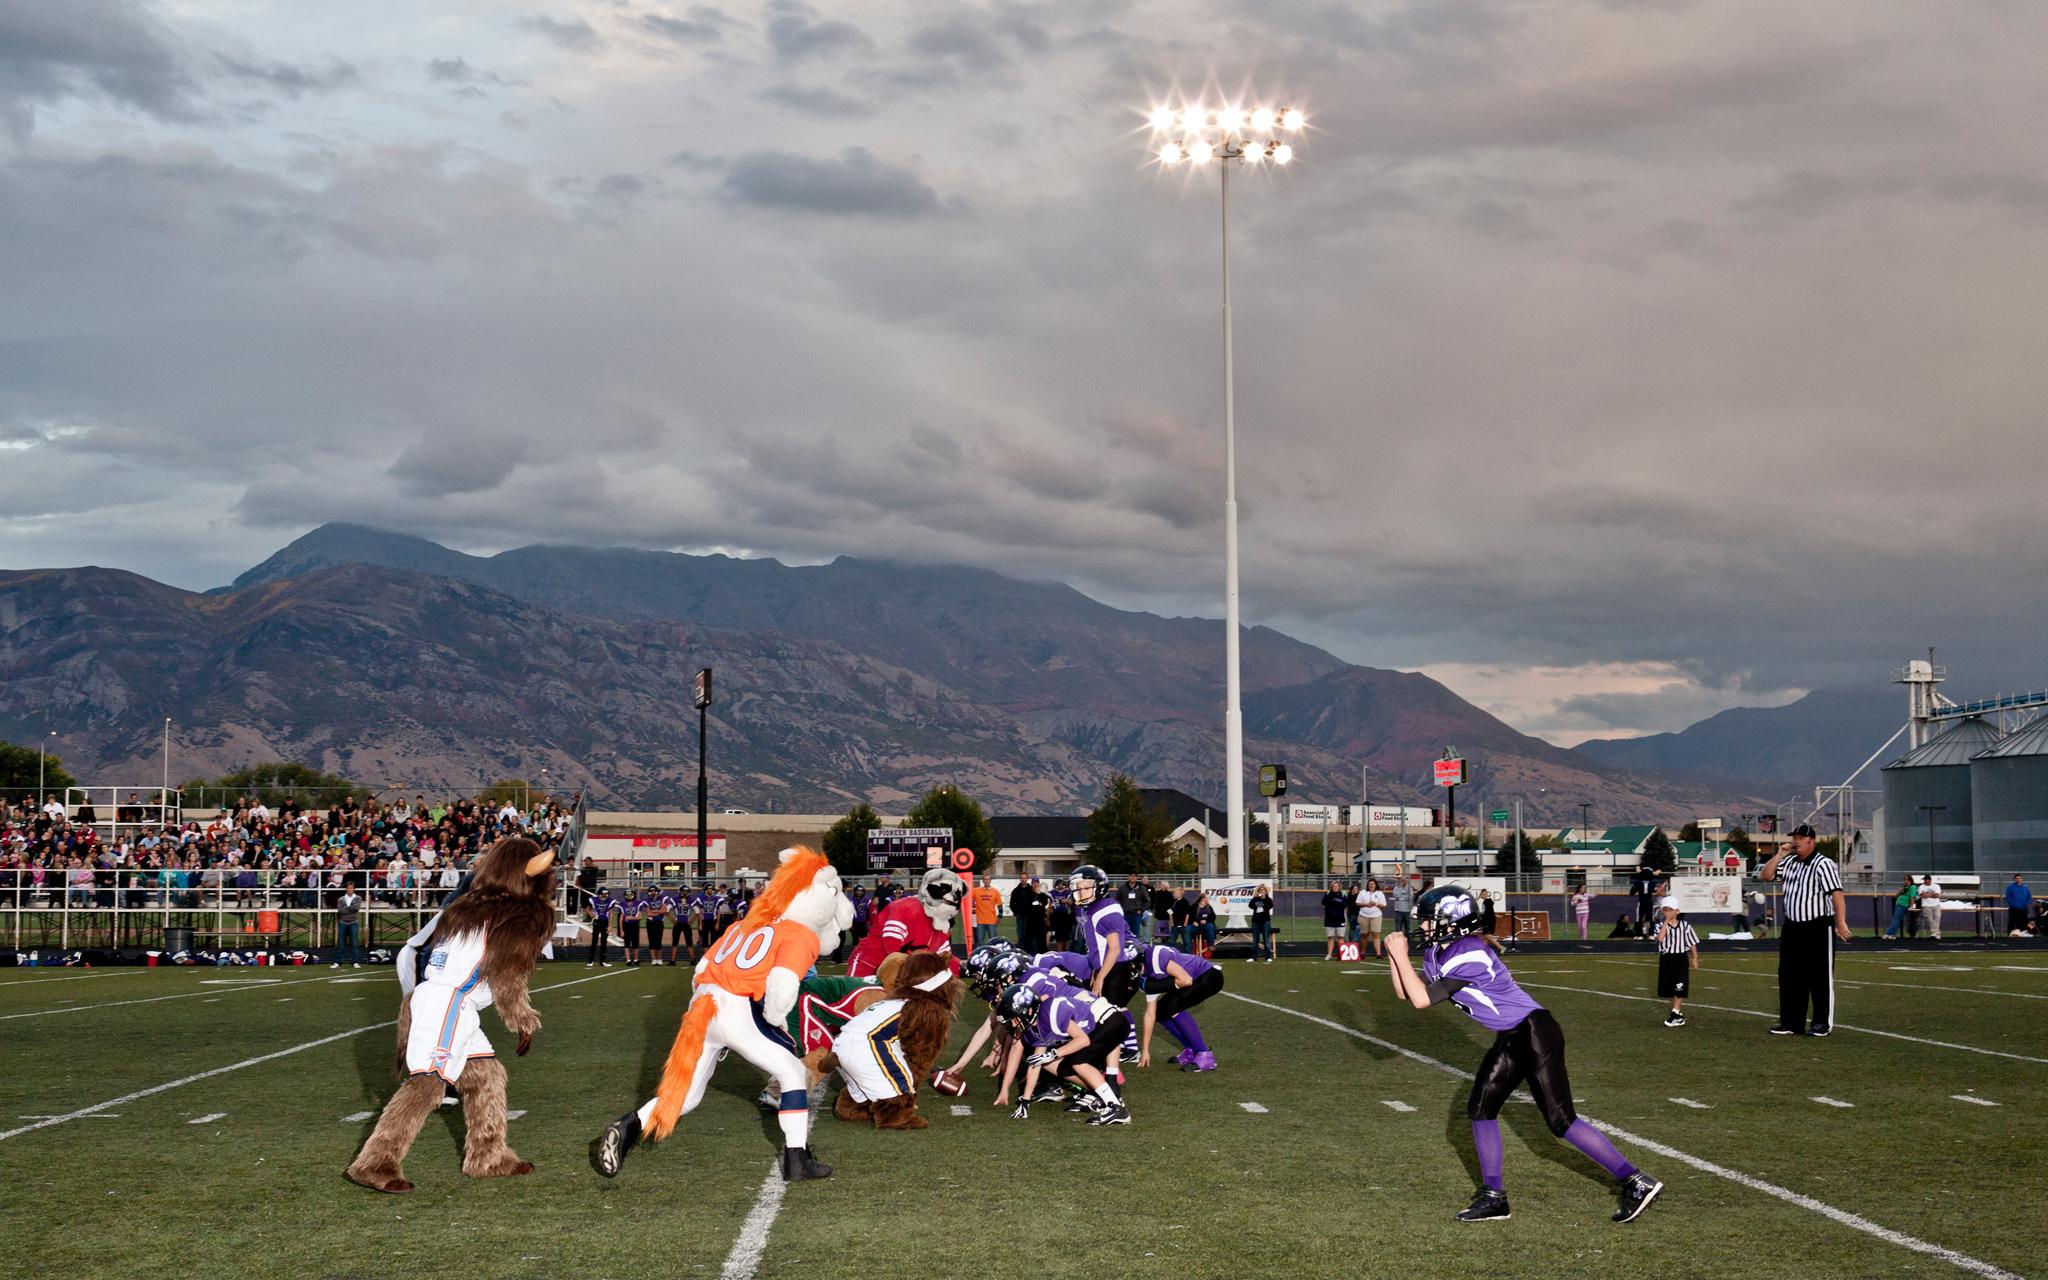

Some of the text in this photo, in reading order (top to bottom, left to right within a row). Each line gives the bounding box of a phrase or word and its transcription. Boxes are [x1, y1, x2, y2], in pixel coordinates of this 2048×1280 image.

[673, 838, 713, 847] TIRS
[927, 847, 942, 864] 2
[1205, 888, 1254, 897] STOCKTON
[714, 924, 775, 970] 00
[1340, 944, 1359, 960] 20
